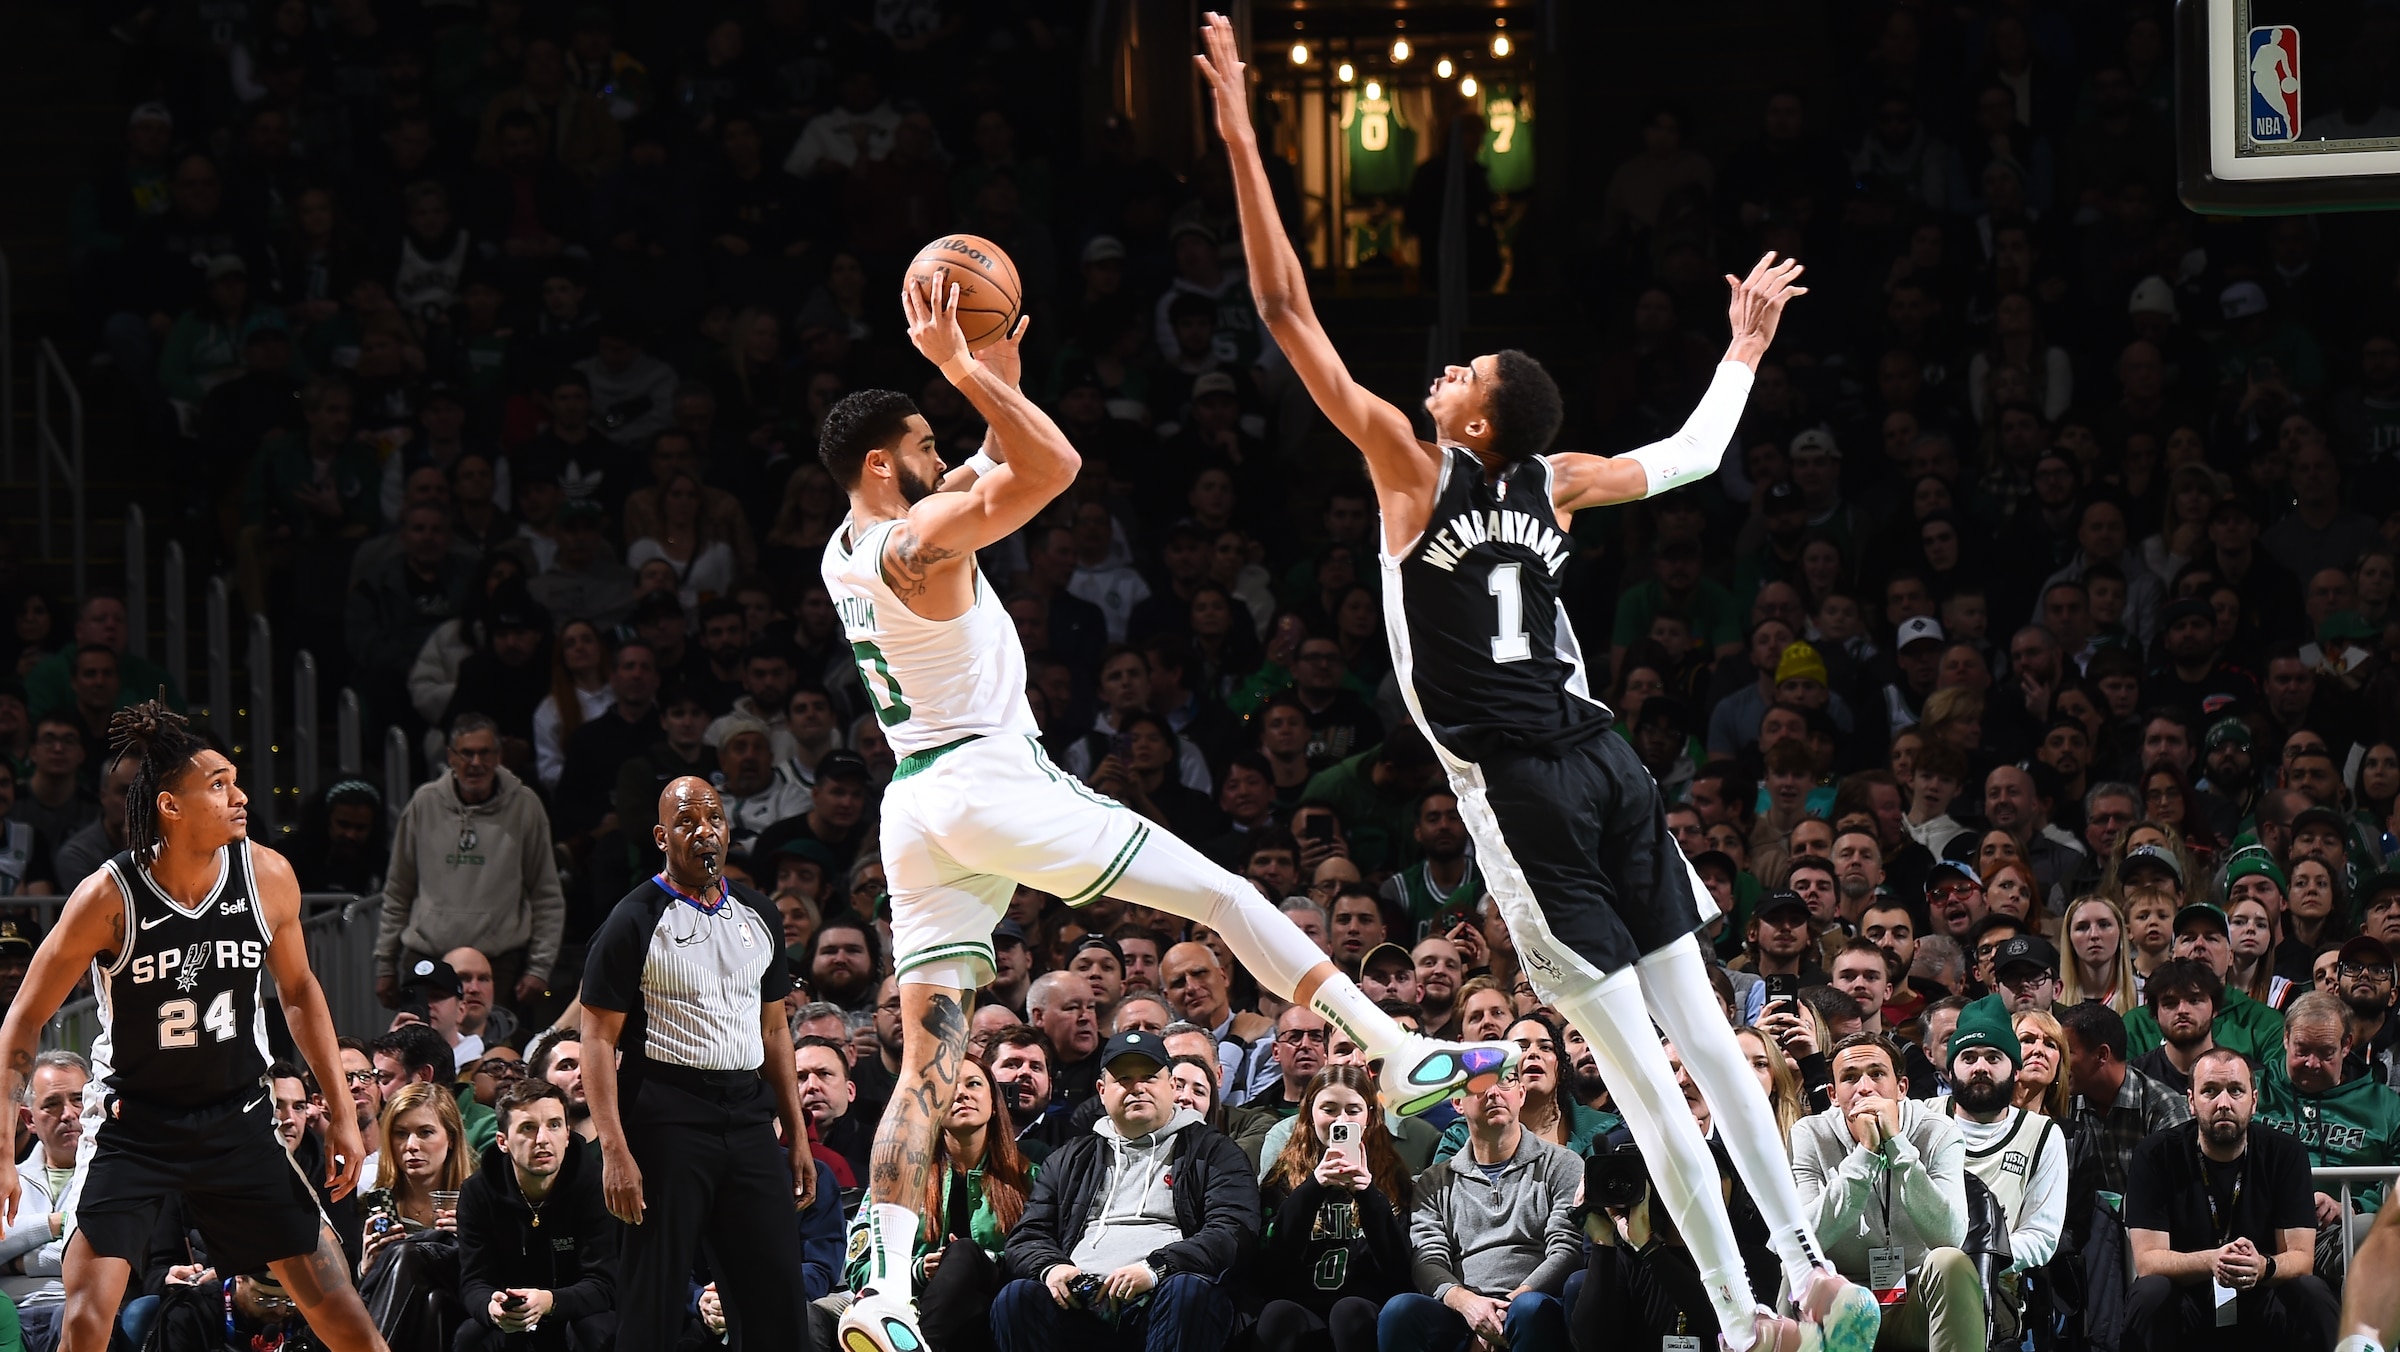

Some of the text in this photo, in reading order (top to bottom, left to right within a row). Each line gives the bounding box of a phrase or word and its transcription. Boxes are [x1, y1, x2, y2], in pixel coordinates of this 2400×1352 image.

[1361, 114, 1389, 151] 0
[1490, 114, 1516, 153] 7
[2256, 117, 2282, 136] NBA
[1421, 509, 1571, 577] WEMBANYAMA
[1488, 562, 1532, 664] 1
[852, 640, 912, 728] 0
[131, 939, 262, 994] SPURS
[157, 989, 238, 1051] 24
[2002, 1162, 2025, 1176] PRINT
[2004, 1151, 2027, 1167] VISTA
[1313, 1246, 1350, 1291] 0
